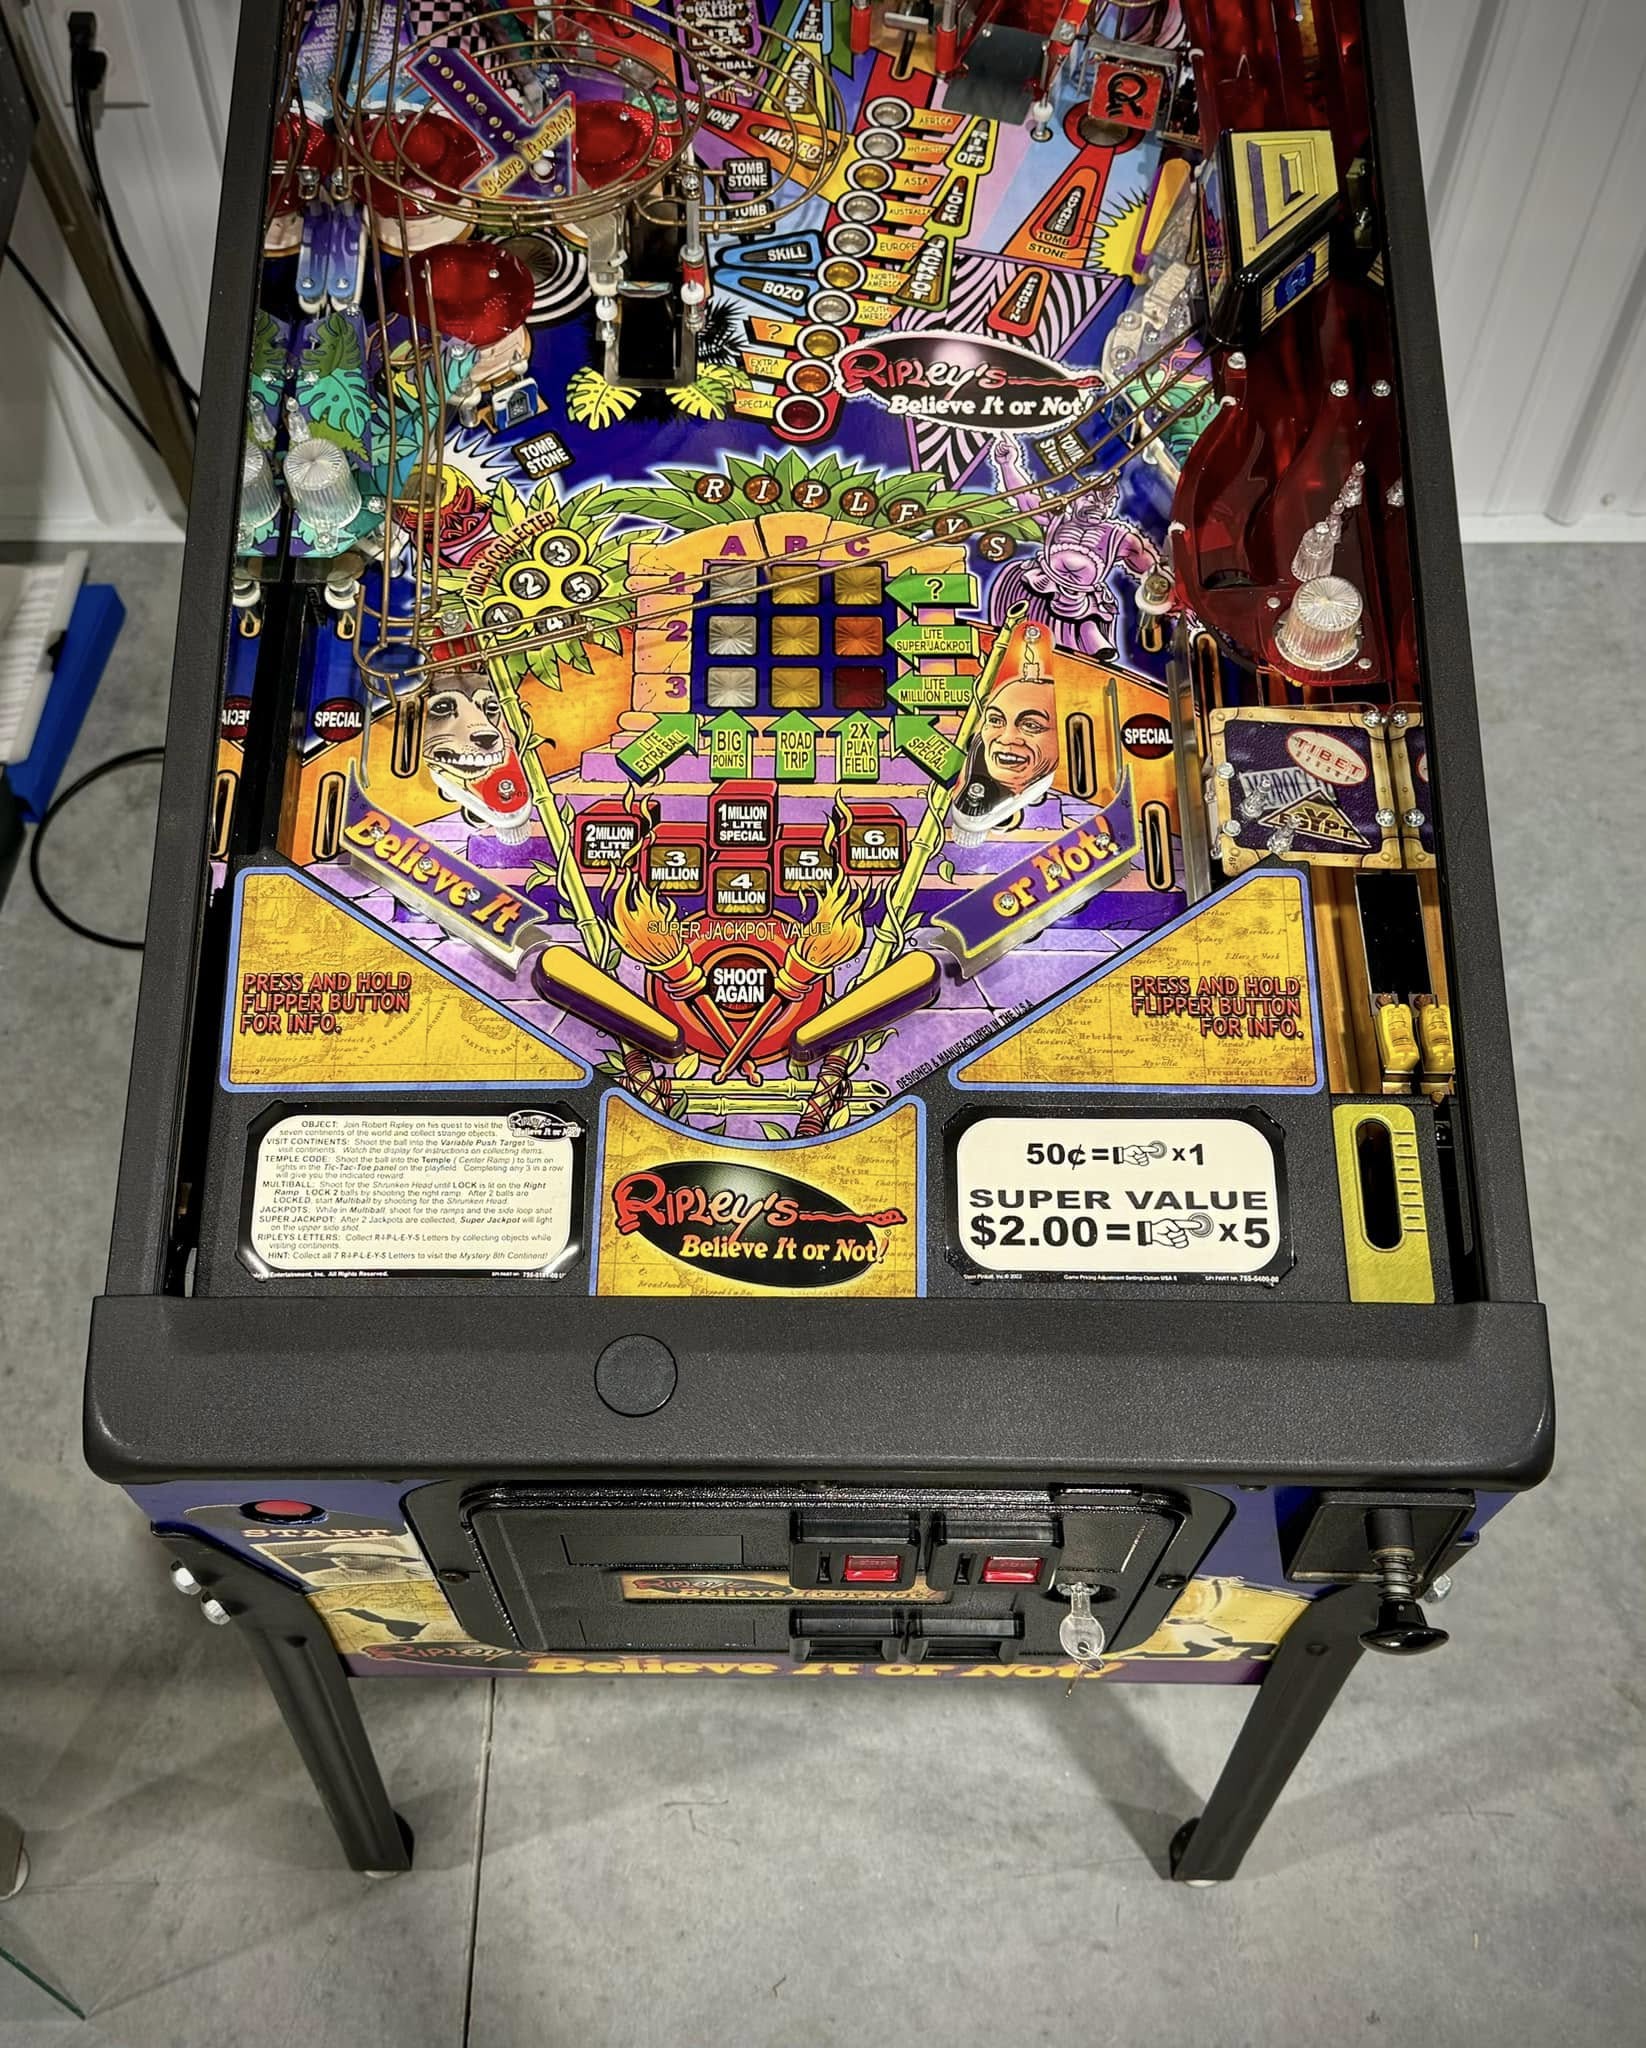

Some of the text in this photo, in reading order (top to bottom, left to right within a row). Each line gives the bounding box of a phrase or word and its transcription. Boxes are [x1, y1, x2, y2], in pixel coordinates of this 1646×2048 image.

[795, 32, 823, 41] HEAD
[957, 152, 985, 166] OFF
[730, 163, 764, 174] TOMB
[728, 175, 768, 187] STONE
[904, 177, 929, 186] ASIA
[888, 208, 932, 216] AUSTRALIA
[880, 241, 917, 252] EUROPE
[1038, 232, 1070, 246] TOMB
[768, 246, 807, 261] SKILL
[1028, 243, 1068, 259] STONE
[867, 280, 901, 288] AMERICA
[871, 273, 898, 281] NORTH
[762, 281, 805, 301] BOZO
[750, 359, 779, 368] EXTRA
[738, 400, 773, 410] SPECIAL
[888, 396, 1094, 416] Believe It or Not!
[520, 437, 557, 459] TOMB
[526, 448, 570, 475] STONE
[470, 511, 557, 595] IDOLS COLLECTED
[549, 540, 571, 567] 3
[719, 536, 746, 556] A
[845, 538, 870, 557] C
[518, 572, 541, 597] 2
[571, 577, 592, 599] 5
[926, 579, 943, 599] ?
[666, 620, 688, 641] 2
[924, 629, 942, 639] LITE
[896, 641, 970, 651] SUPER JACKPOT
[665, 676, 688, 698] 3
[924, 679, 945, 690] LITE
[900, 691, 970, 702] MILLION PLUS
[314, 711, 362, 728] SPECIAL
[850, 724, 871, 739] 2X
[1124, 728, 1173, 744] SPECIAL
[640, 732, 662, 750] LITE
[717, 731, 741, 751] BIG
[780, 732, 812, 750] ROAD
[846, 741, 875, 757] PLAY
[925, 735, 950, 755] LITE
[635, 730, 688, 772] EXTRA BALL
[908, 738, 946, 771] SPECIAL
[1297, 738, 1362, 777] TIBET
[713, 755, 744, 768] POINTS
[784, 752, 809, 769] TRIP
[845, 758, 877, 774] FIELD
[732, 821, 762, 830] LITE
[720, 830, 766, 841] SPECIAL
[864, 830, 886, 846] 6
[600, 842, 630, 850] LITE
[852, 847, 899, 860] MILLION
[588, 850, 621, 859] EXTRA
[664, 851, 686, 866] 3
[798, 851, 819, 866] 5
[344, 811, 523, 933] Believe It
[651, 868, 699, 880] MILLION
[784, 868, 832, 880] MILLION
[993, 815, 1120, 918] or Not!
[730, 873, 752, 889] 4
[718, 891, 766, 904] MILLION
[647, 922, 832, 942] SUPER JACKPOT VALUE
[243, 972, 412, 993] PRESS AND HOLD
[713, 968, 768, 986] SHOOT
[716, 986, 764, 1003] AGAIN
[1130, 976, 1300, 997] PRESS AND HOLD
[242, 992, 410, 1013] FLIPPER BUTTON
[1131, 996, 1301, 1018] FLIPPER BUTTON
[240, 1014, 342, 1034] FOR INFO.
[1200, 1018, 1304, 1040] FOR INFO.
[896, 1063, 932, 1089] DESIGNED
[937, 1024, 992, 1064] MANUFACTURED
[302, 1120, 338, 1128] OBJECT:
[290, 1138, 350, 1146] CONTINENTS:
[500, 1140, 526, 1148] Target
[374, 1165, 397, 1173] panel
[524, 1182, 546, 1190] Right
[968, 1189, 1268, 1211] SUPER VALUE
[260, 1206, 310, 1214] JACKPOTS:
[460, 1216, 485, 1225] Super
[486, 1216, 520, 1225] Jackpot
[680, 1234, 889, 1264] Believe It or Not!
[242, 1529, 390, 1538] START
[528, 1658, 778, 1674] Believe
[793, 1662, 867, 1676] It
[874, 1664, 954, 1678] or
